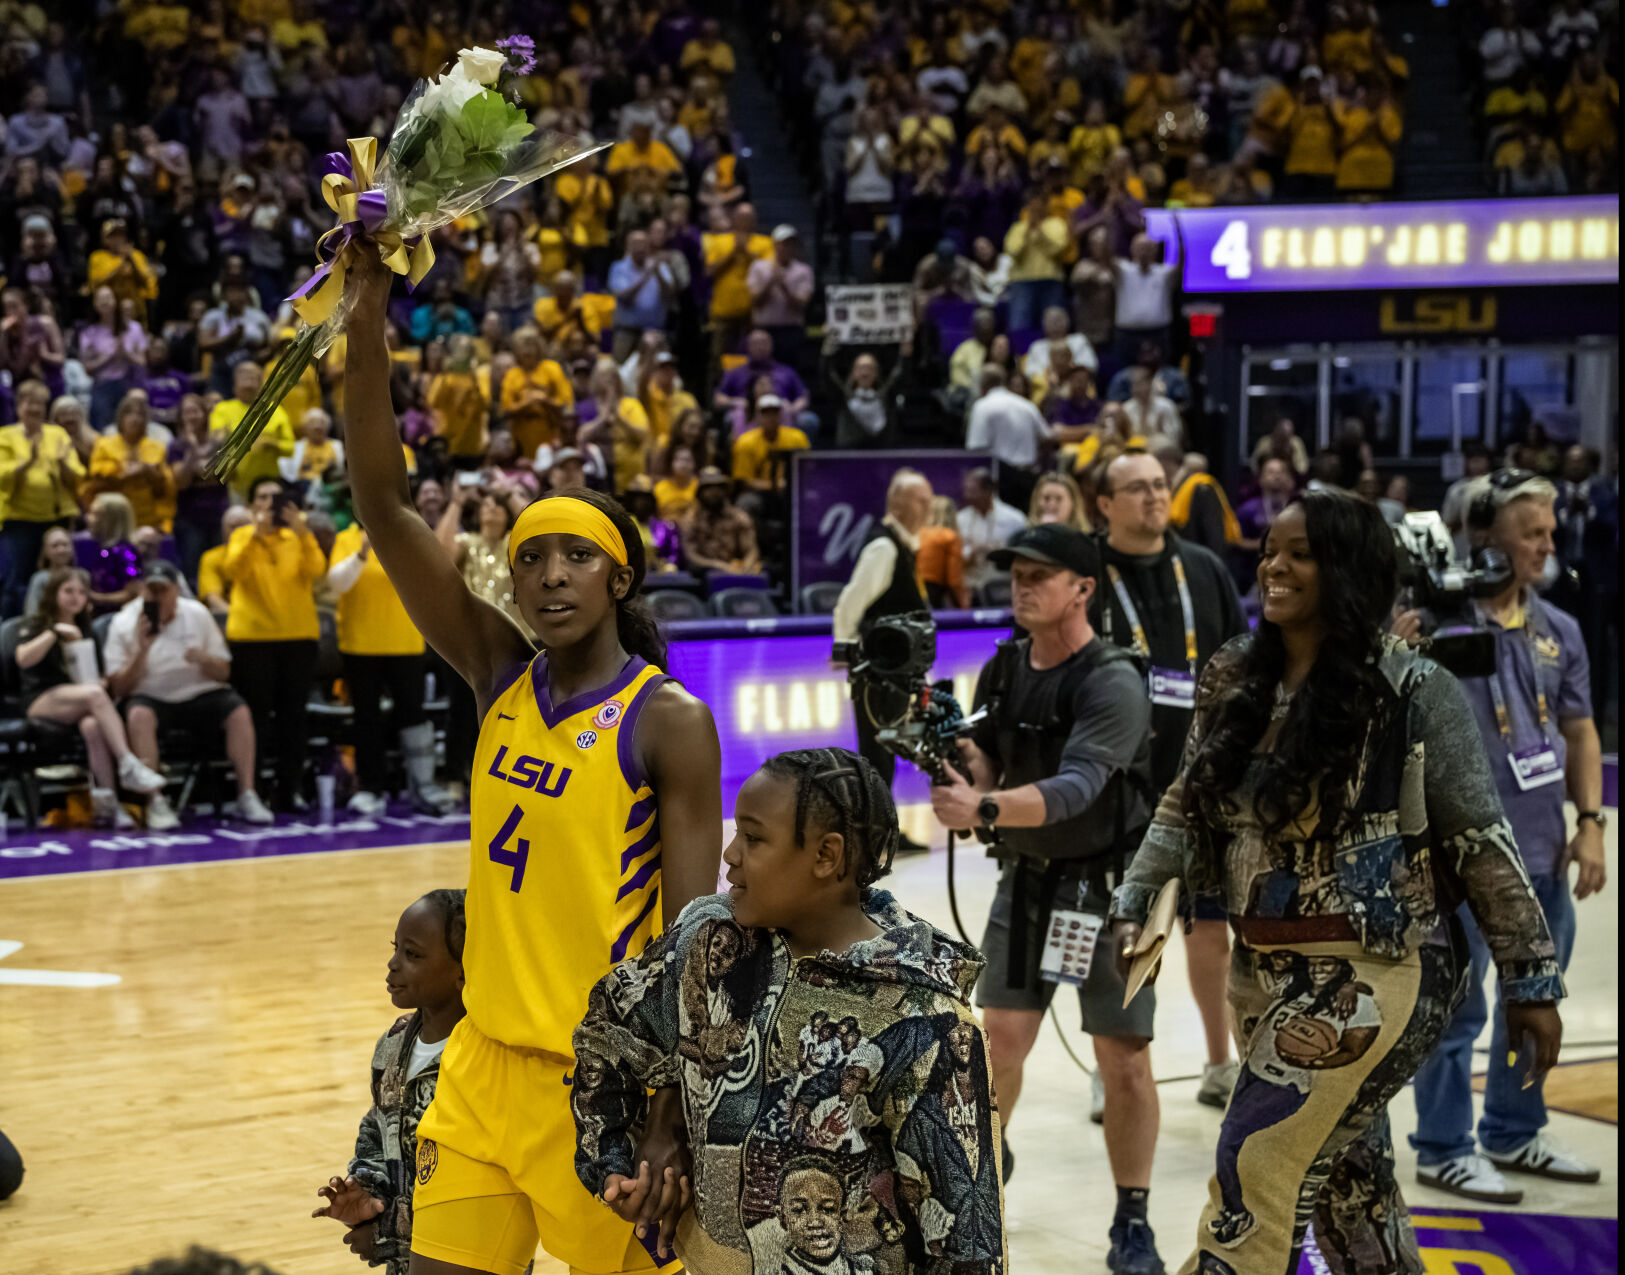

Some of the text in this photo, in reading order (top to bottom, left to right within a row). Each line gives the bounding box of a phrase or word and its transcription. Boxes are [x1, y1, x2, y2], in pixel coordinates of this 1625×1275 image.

[1210, 217, 1619, 279] 4 FLAU'JAE JOHN
[1379, 296, 1497, 333] LSU
[577, 731, 597, 749] SEC
[488, 744, 572, 799] LSU
[488, 804, 530, 894] 4
